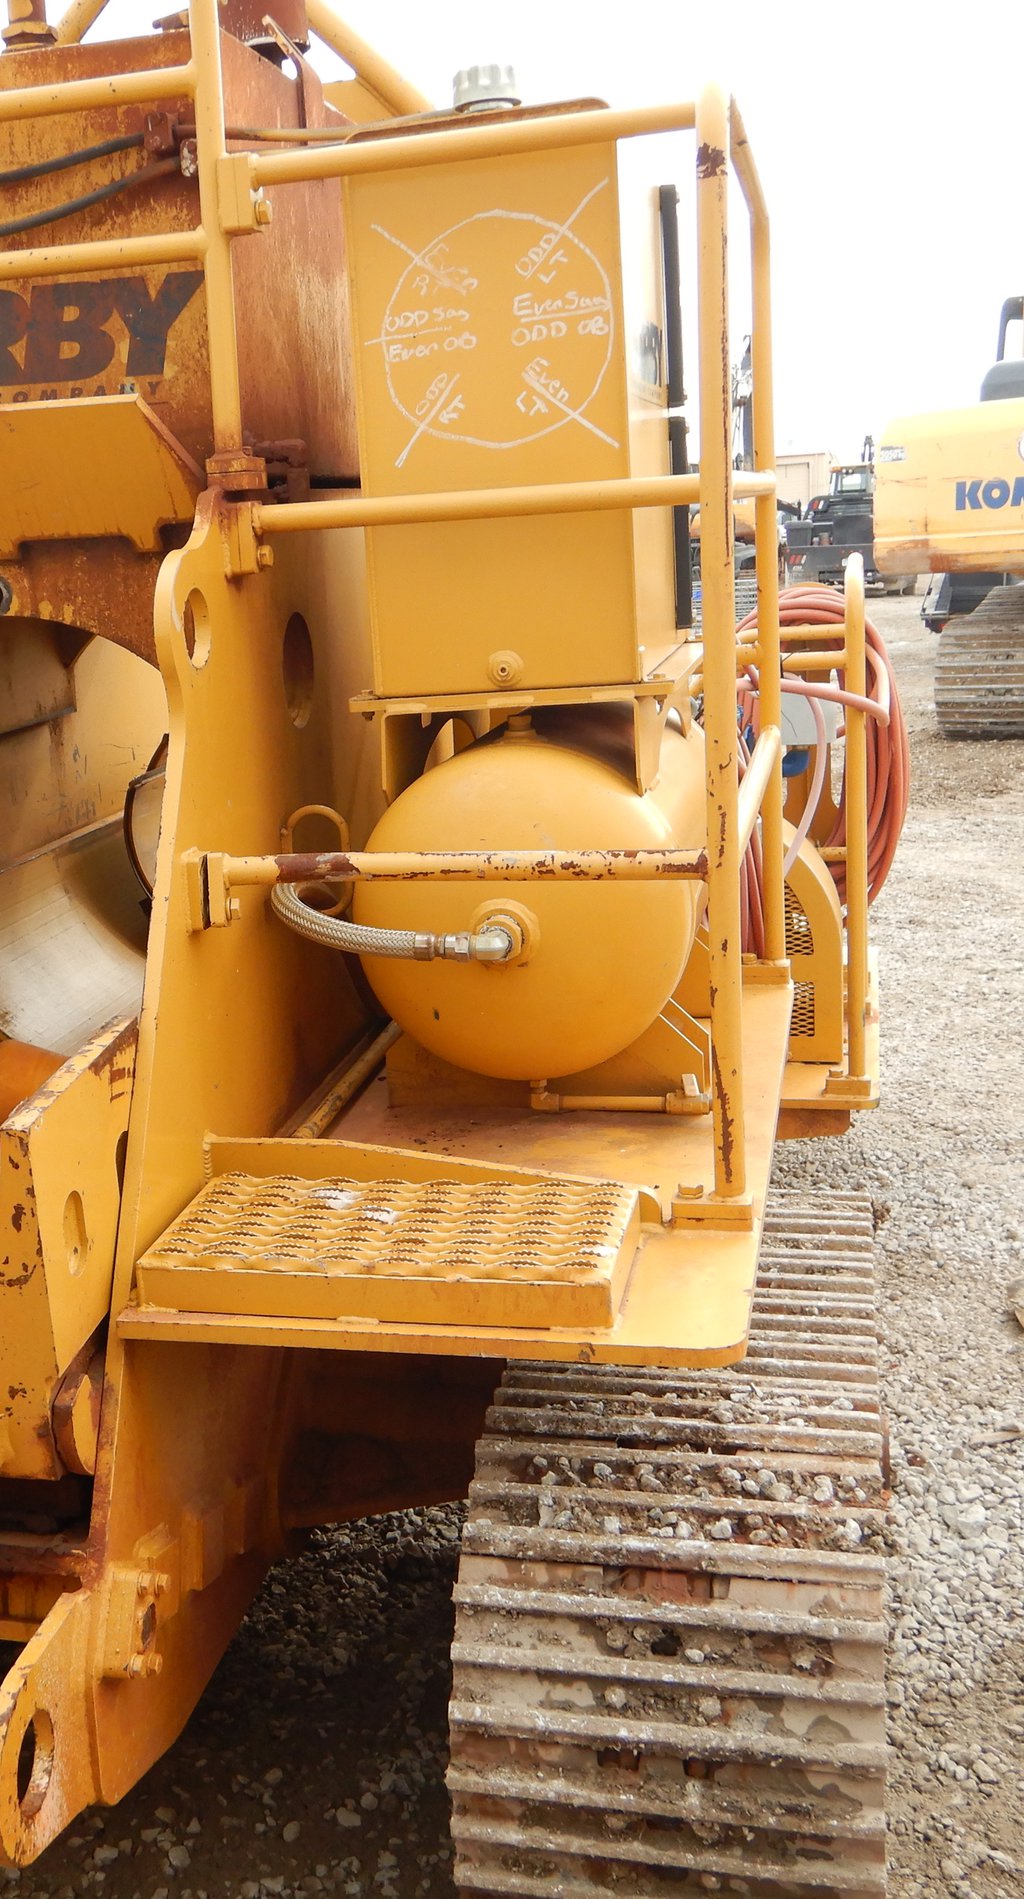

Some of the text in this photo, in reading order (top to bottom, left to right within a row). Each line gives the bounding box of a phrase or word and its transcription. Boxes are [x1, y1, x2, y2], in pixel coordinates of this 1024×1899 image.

[512, 292, 563, 316] Even
[385, 309, 429, 332] ODD
[511, 320, 568, 346] ODD
[388, 342, 439, 362] Even
[525, 356, 569, 402] Even
